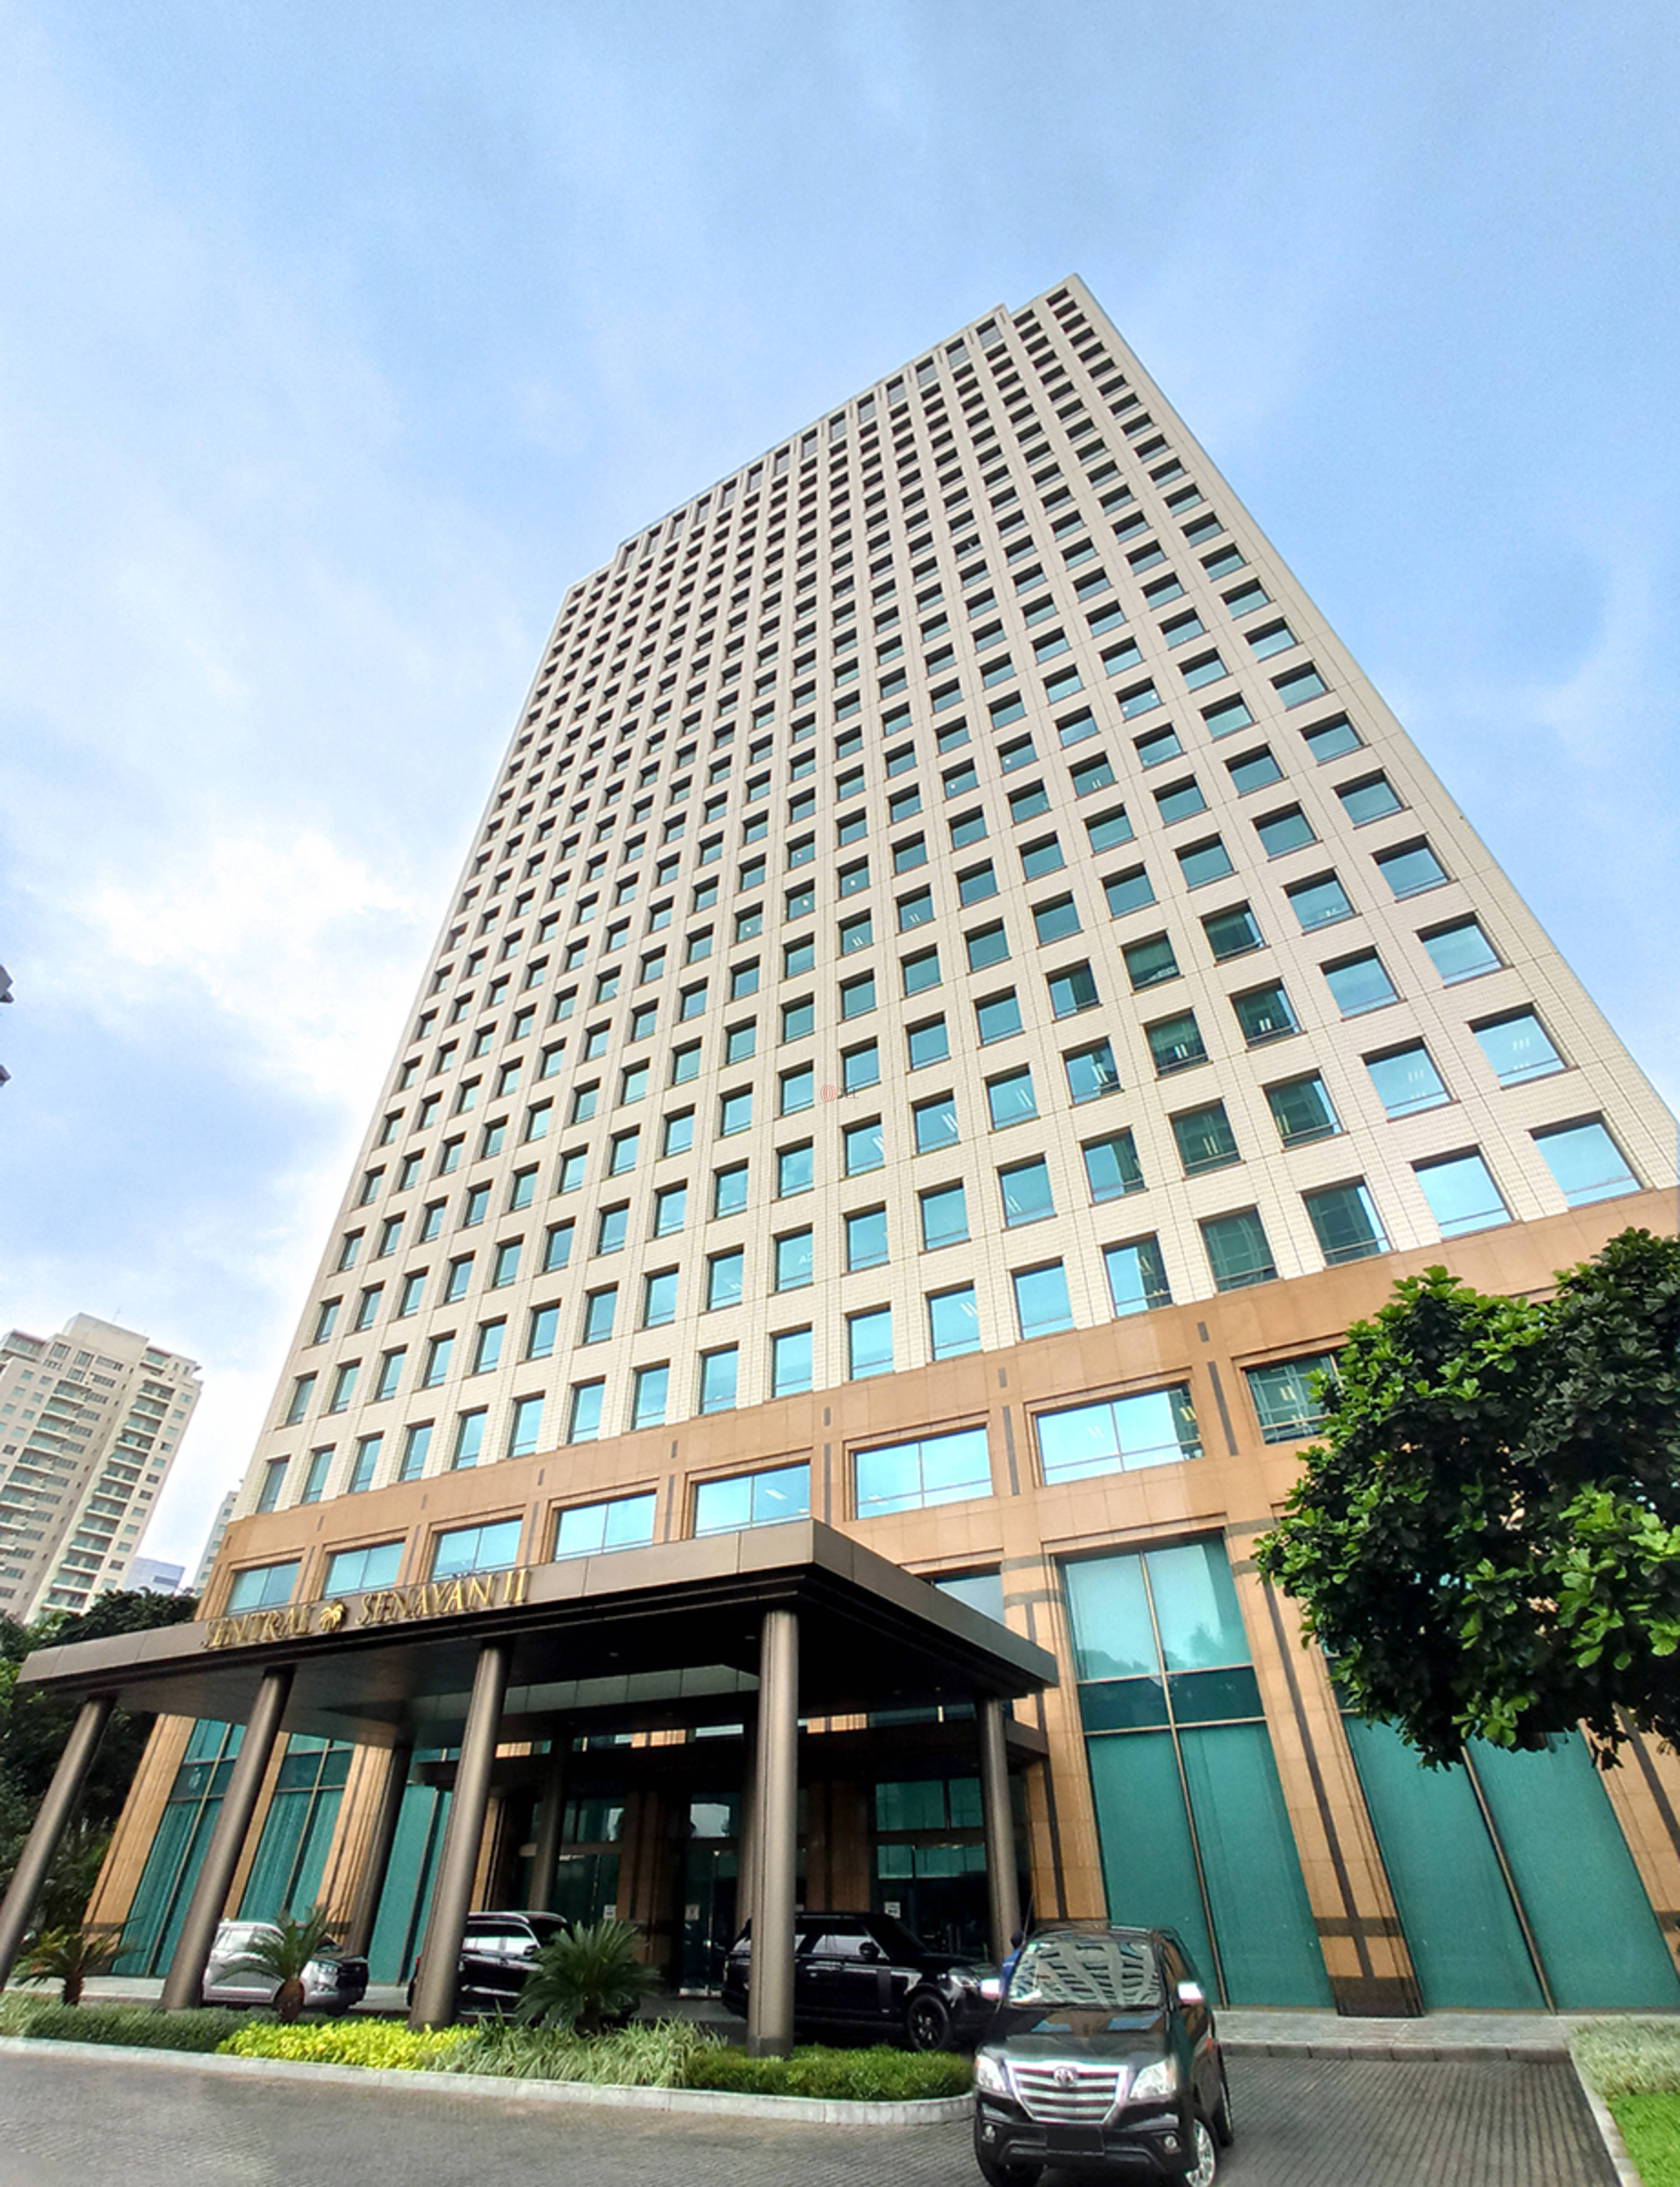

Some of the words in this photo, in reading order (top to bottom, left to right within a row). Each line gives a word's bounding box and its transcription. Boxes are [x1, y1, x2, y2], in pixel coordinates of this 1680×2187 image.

[200, 1605, 312, 1649] SENTRAL
[355, 1574, 495, 1625] SENAYAN
[503, 1568, 529, 1603] II
